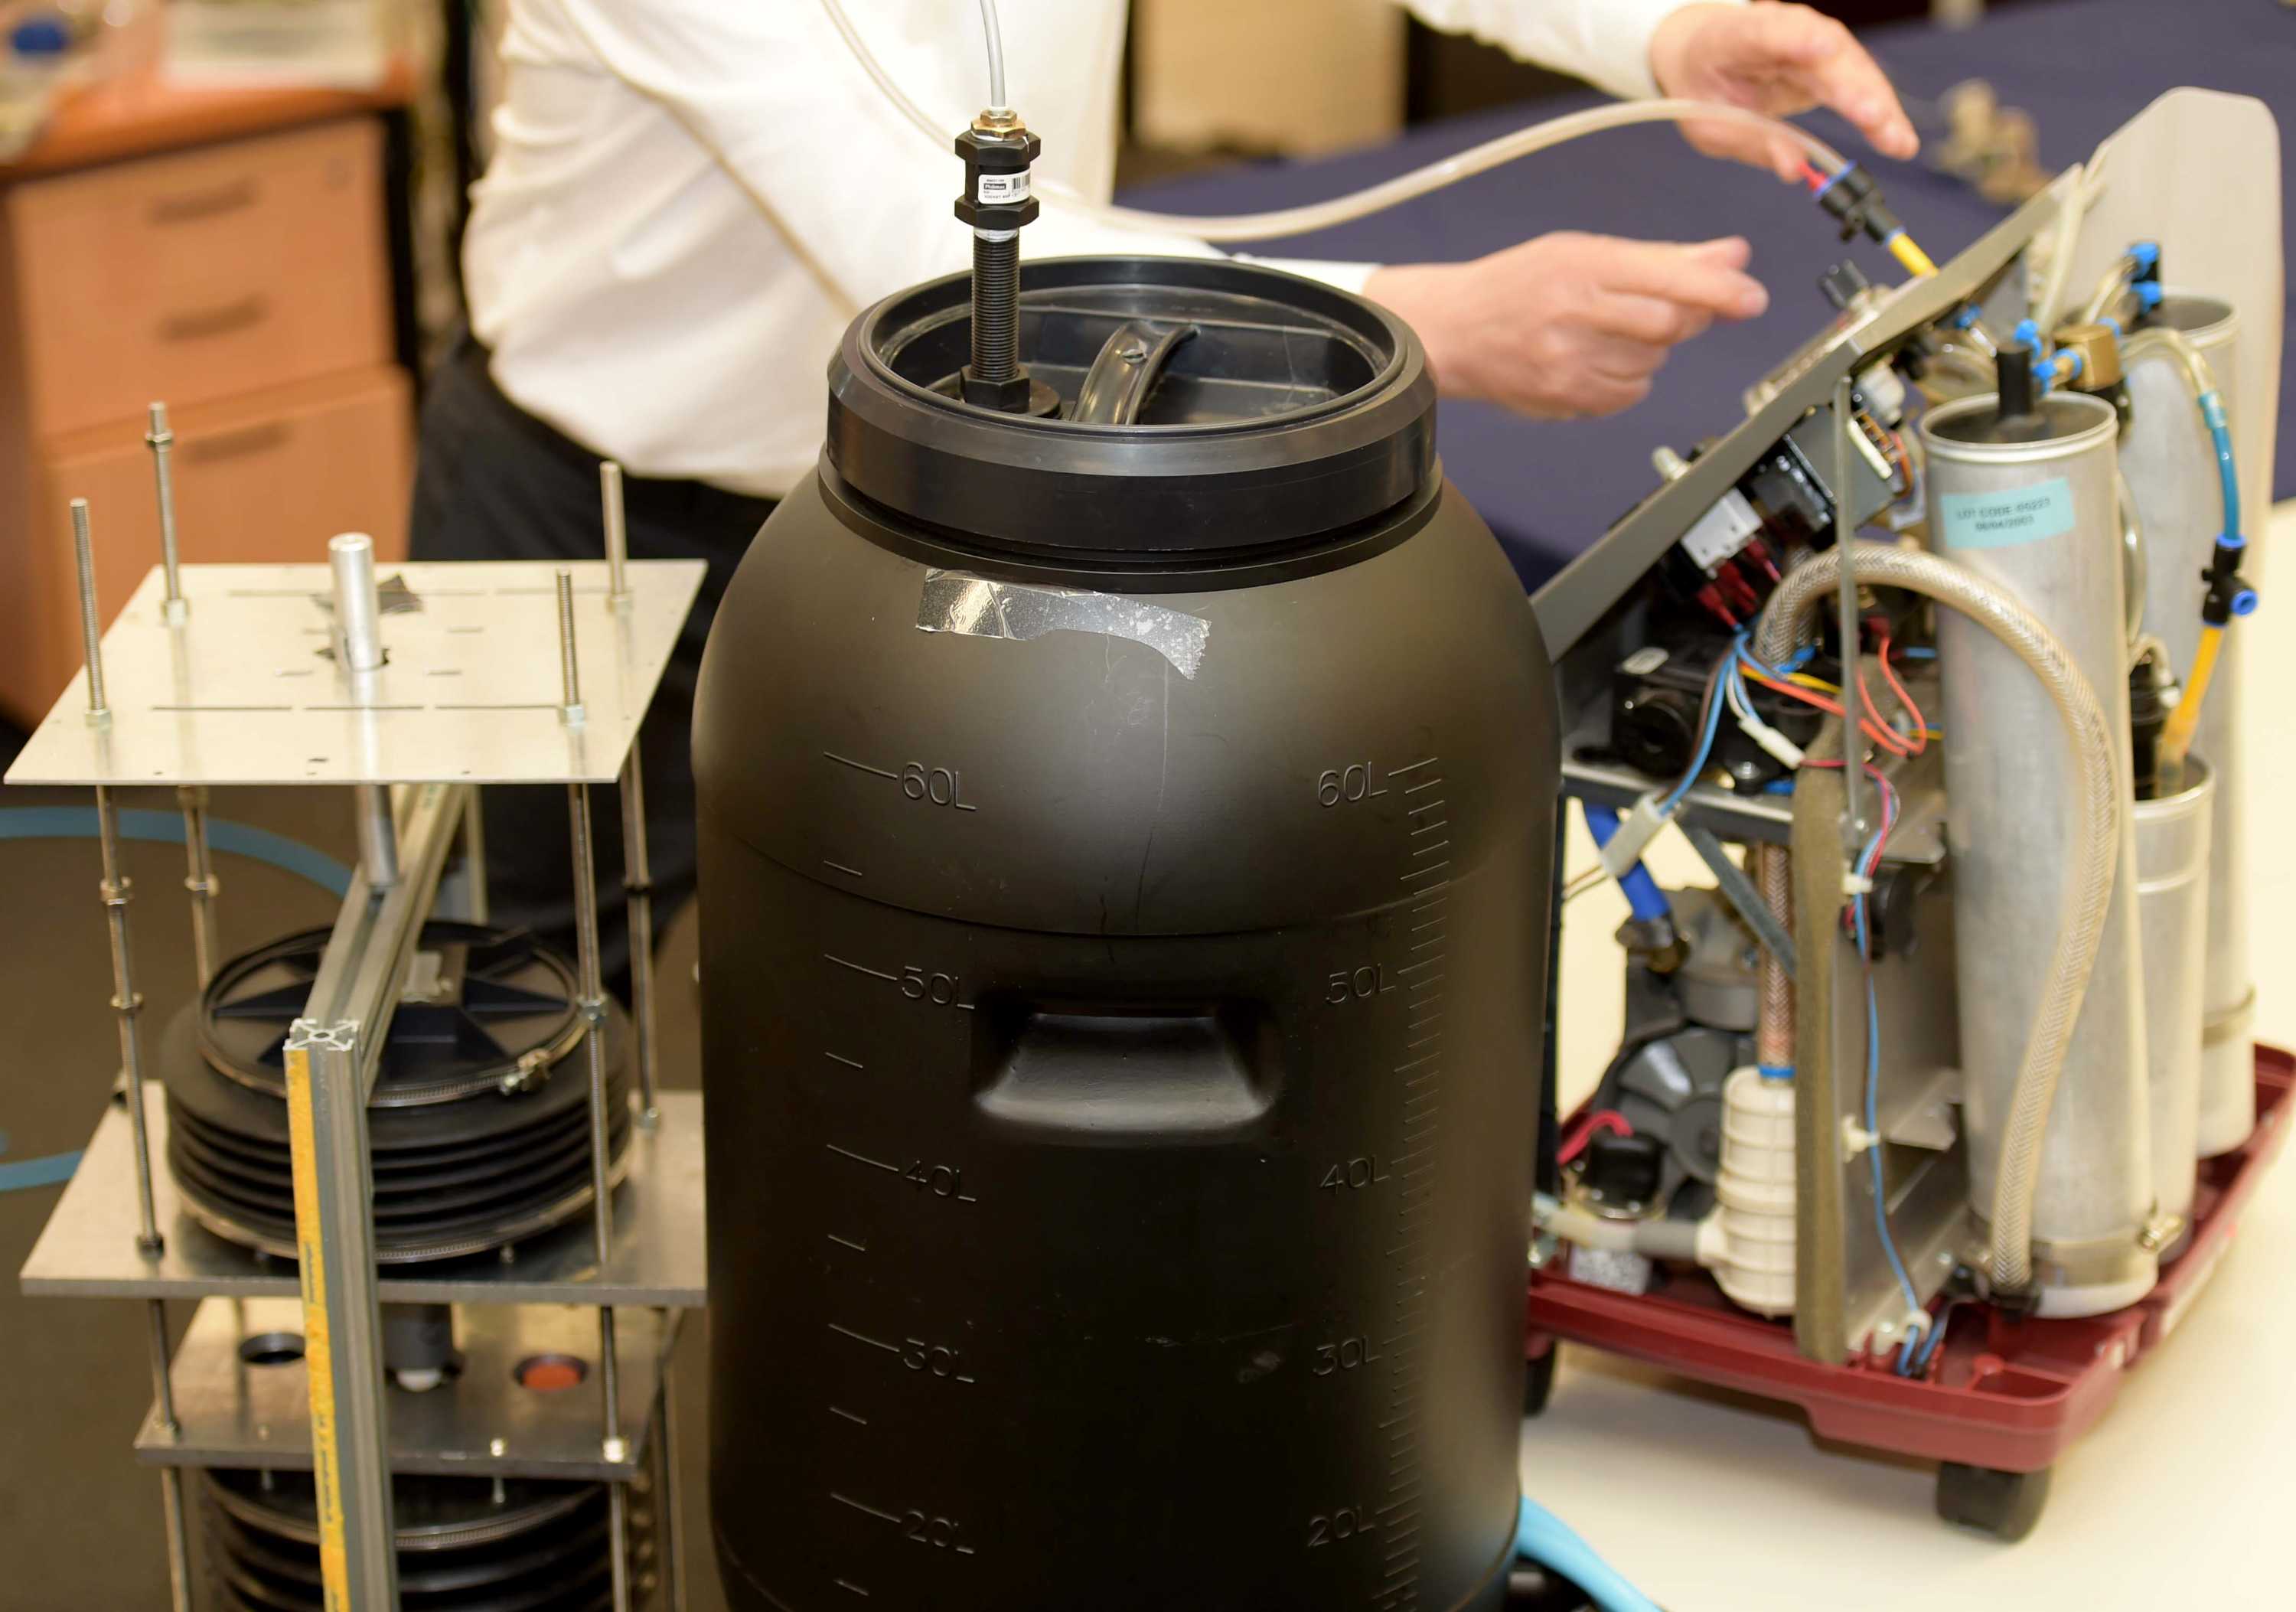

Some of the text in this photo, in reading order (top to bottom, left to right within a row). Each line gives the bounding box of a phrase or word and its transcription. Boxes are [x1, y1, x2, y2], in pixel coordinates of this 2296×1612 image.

[1979, 505, 2013, 518] CODE
[902, 761, 977, 812] 60L
[1317, 761, 1388, 808] 60L
[901, 965, 976, 1010] 50L
[1326, 962, 1397, 1004] 50L
[902, 1159, 977, 1202] 40L
[1320, 1153, 1391, 1196] 40L
[902, 1336, 975, 1383] 30L
[1313, 1334, 1382, 1377] 30L
[905, 1509, 975, 1555] 20L
[1306, 1504, 1376, 1548] 20L
